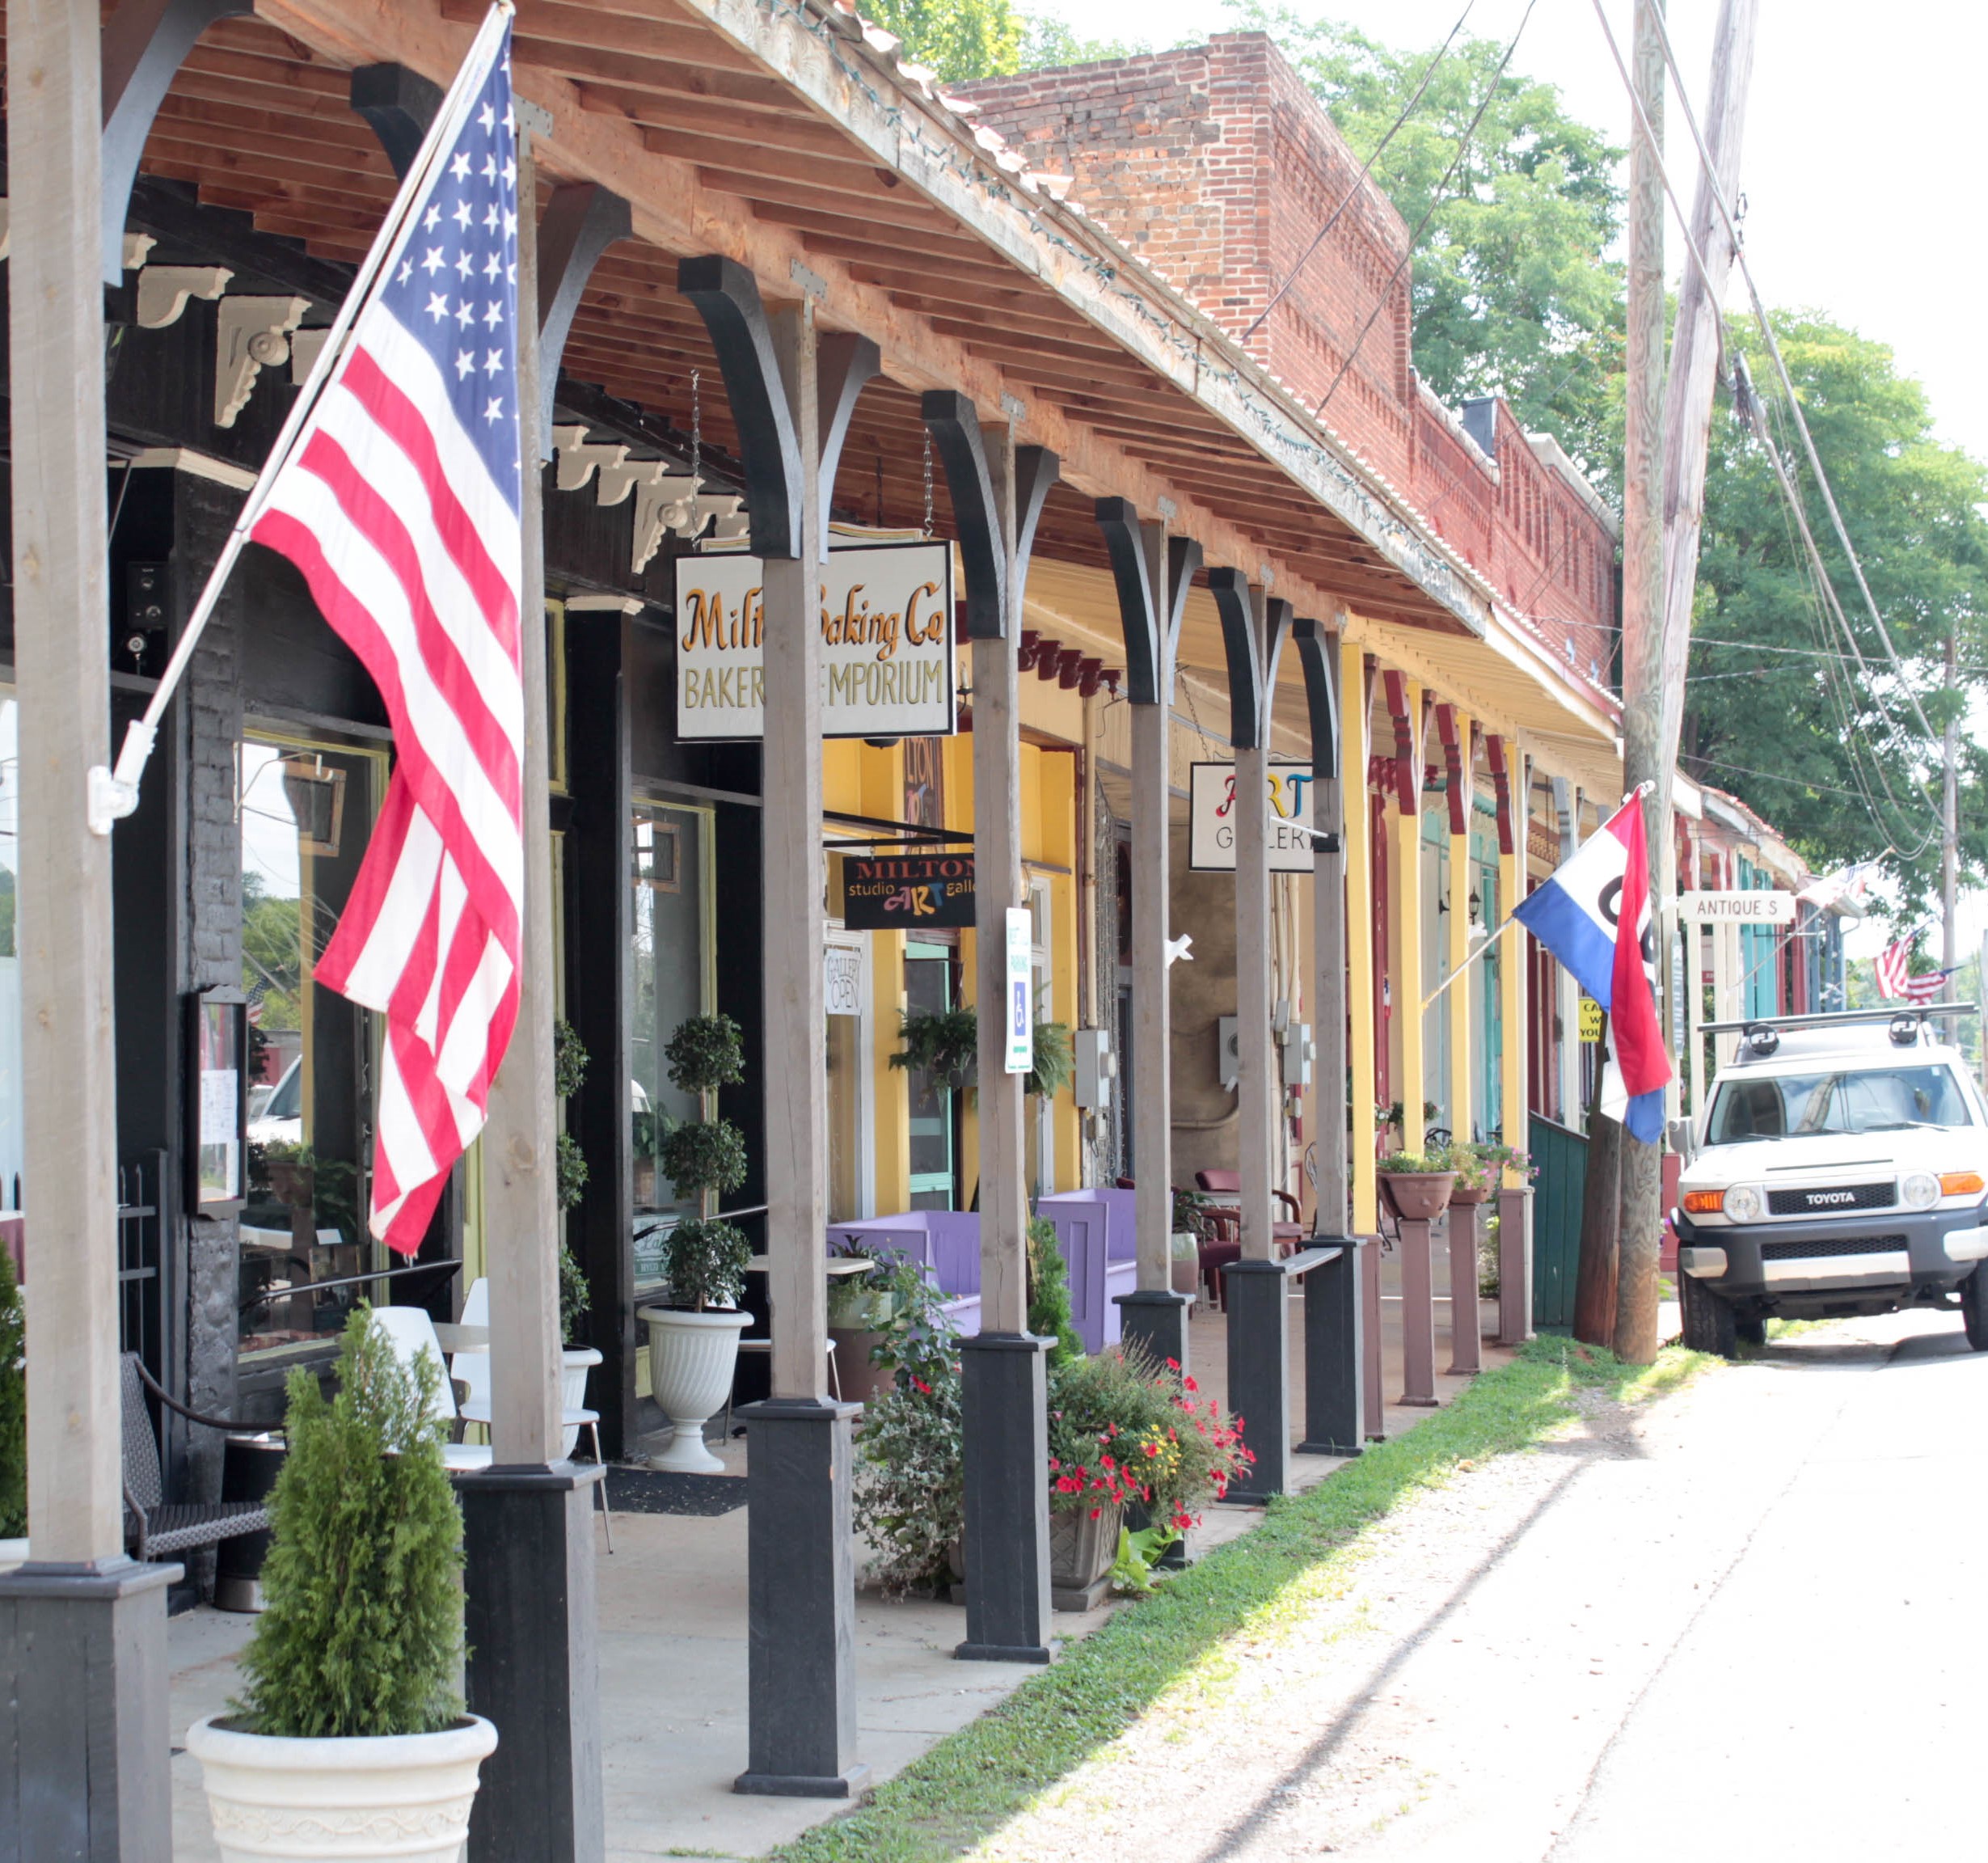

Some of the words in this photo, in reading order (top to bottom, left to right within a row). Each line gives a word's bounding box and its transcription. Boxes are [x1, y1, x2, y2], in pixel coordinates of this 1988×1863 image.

[682, 587, 763, 652] Milt
[684, 666, 766, 708] BAKER
[821, 660, 943, 707] MPORIUM
[849, 881, 895, 896] studio
[884, 882, 944, 916] ART
[831, 978, 859, 1009] OPEN
[1806, 1192, 1855, 1205] TOYOTA
